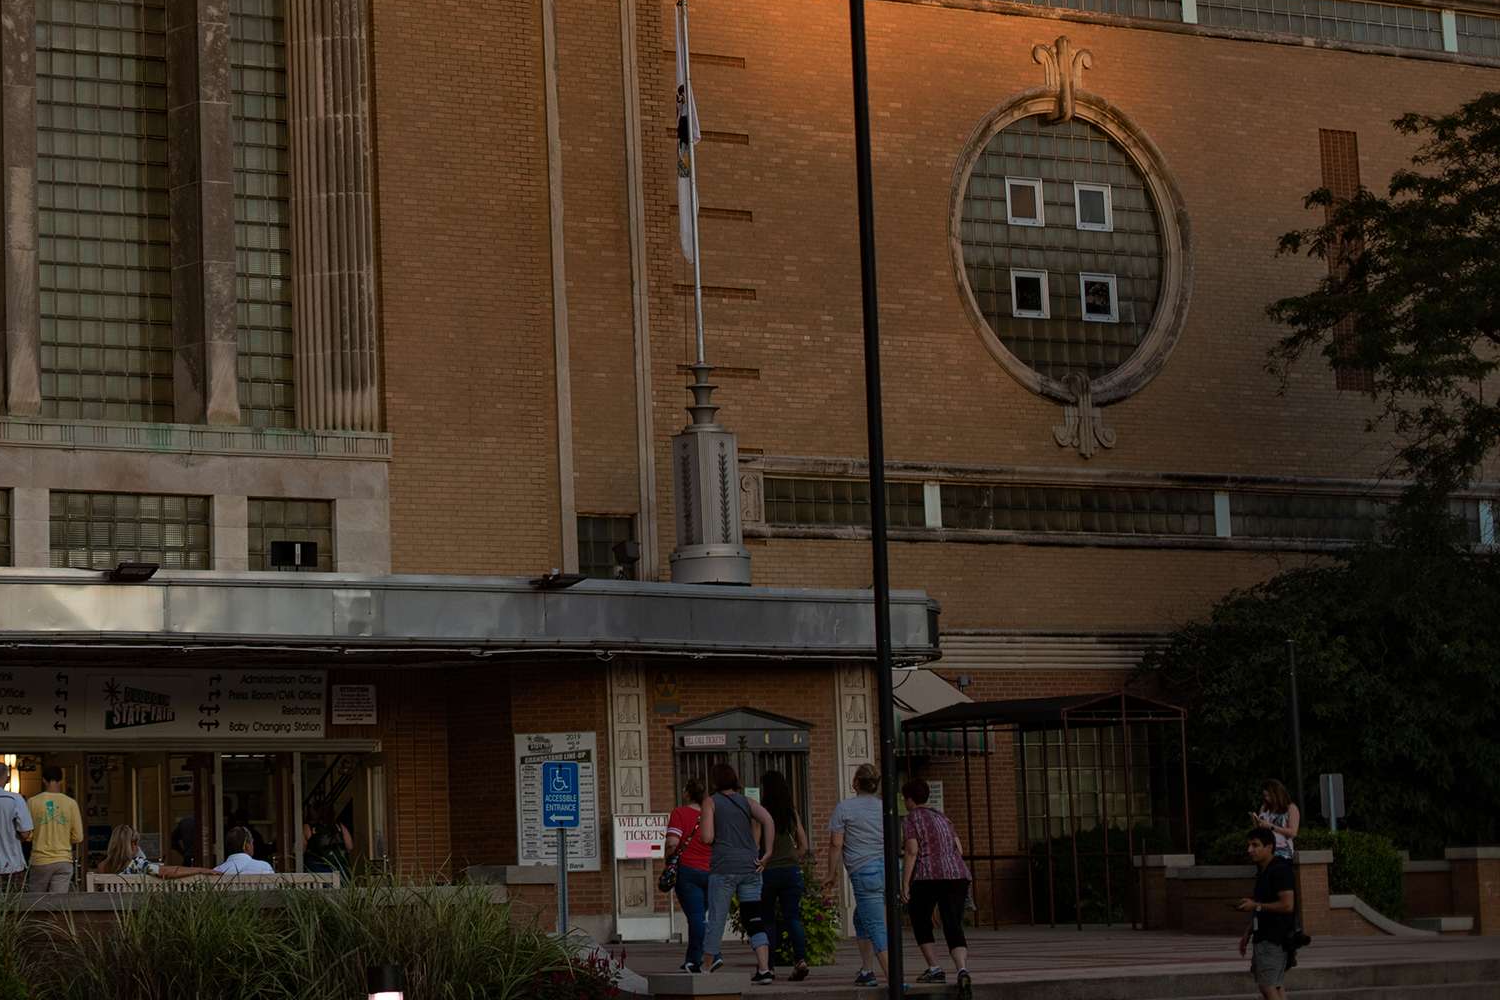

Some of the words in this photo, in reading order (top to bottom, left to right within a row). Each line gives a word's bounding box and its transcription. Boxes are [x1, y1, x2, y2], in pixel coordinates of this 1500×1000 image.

[298, 674, 323, 684] Office
[298, 690, 323, 700] Office
[6, 704, 33, 715] Office
[112, 702, 149, 726] STATE
[282, 705, 322, 715] Restrooms
[228, 721, 250, 734] Baby
[253, 721, 292, 734] Changing
[294, 721, 322, 732] Station
[545, 794, 577, 802] ACCESSIBLE
[545, 803, 577, 811] ENTRANCE
[618, 817, 643, 827] WILL
[624, 830, 665, 841] TICKETS
